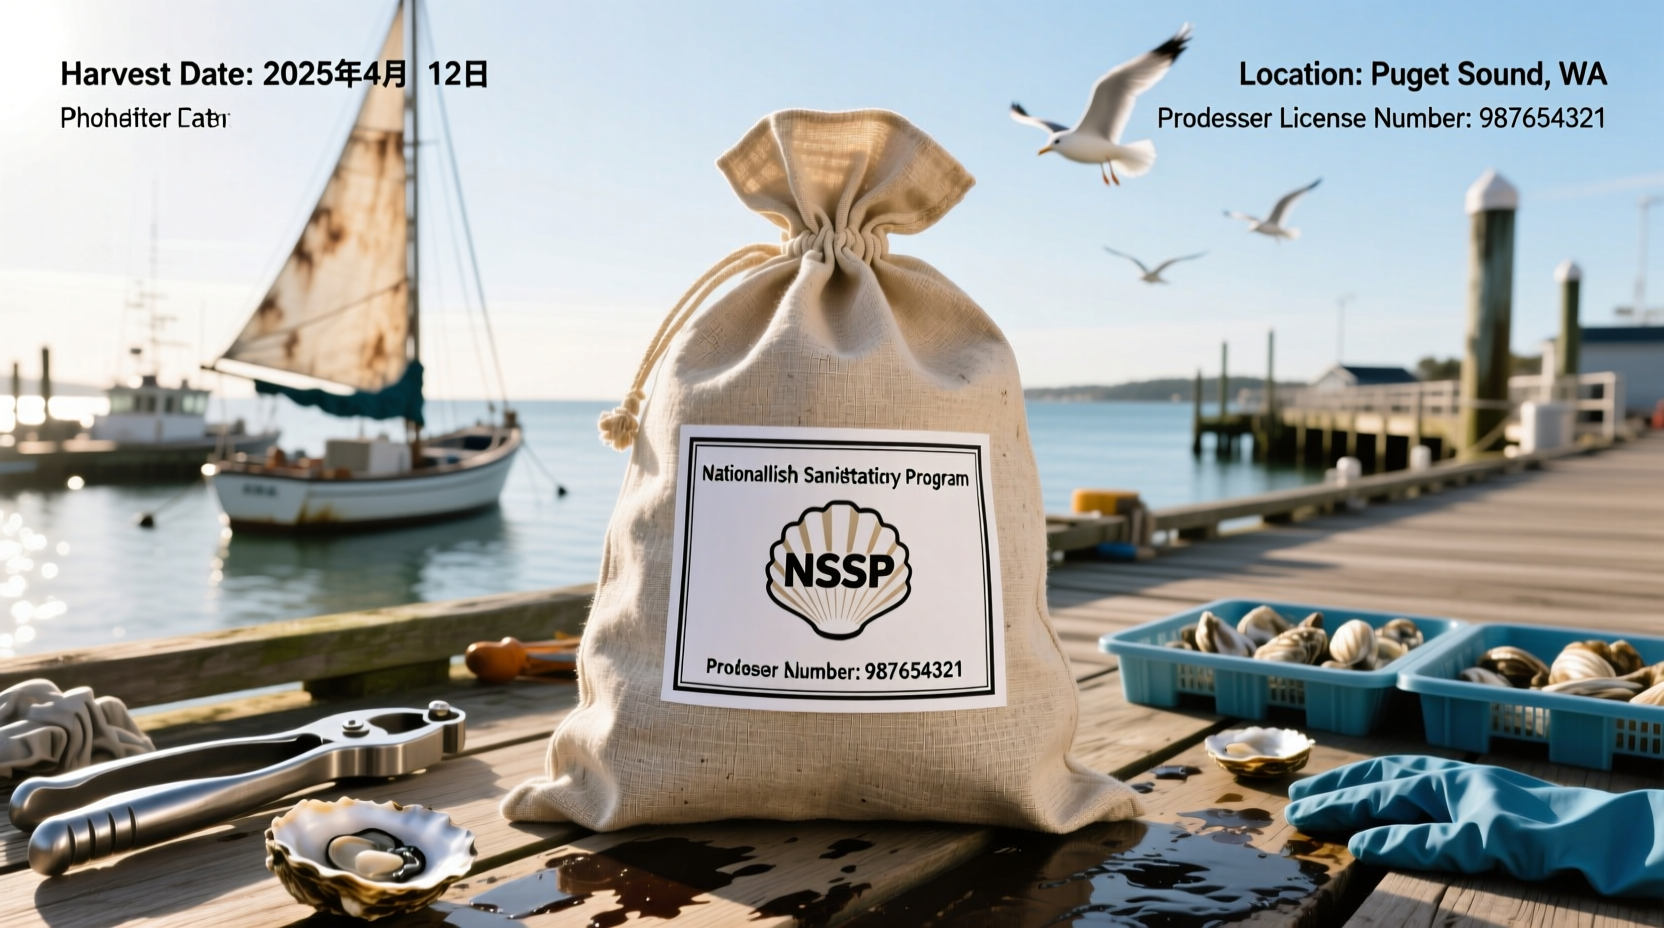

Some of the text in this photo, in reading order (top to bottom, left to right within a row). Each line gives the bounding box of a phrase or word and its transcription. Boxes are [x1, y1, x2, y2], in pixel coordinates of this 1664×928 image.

[702, 464, 799, 484] Nationallish
[905, 468, 970, 491] Program
[784, 552, 895, 589] NSSP
[784, 660, 861, 681] Number:
[864, 659, 963, 681] 987654321
